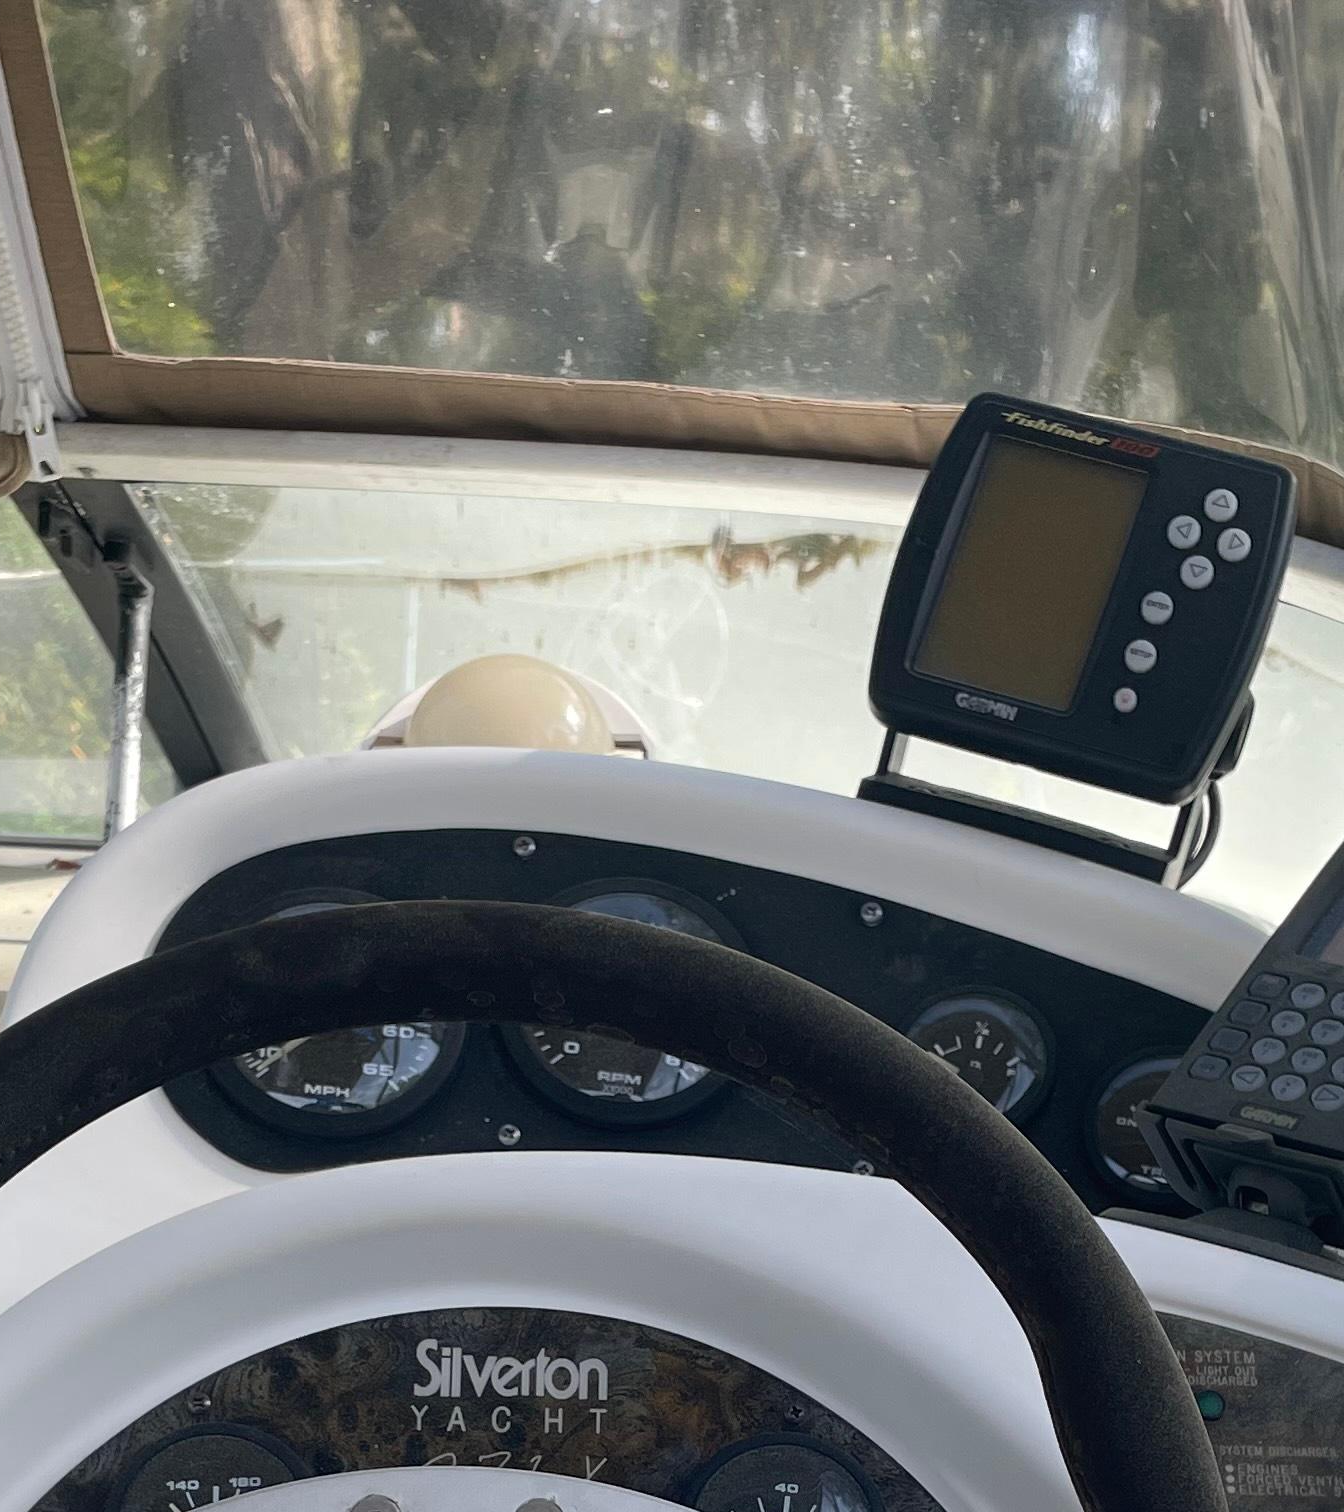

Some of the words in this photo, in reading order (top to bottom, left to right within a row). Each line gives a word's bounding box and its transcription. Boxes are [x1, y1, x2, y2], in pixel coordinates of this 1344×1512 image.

[956, 692, 1019, 721] GARMIN
[362, 1063, 394, 1077] 65
[596, 1070, 643, 1086] RPM
[303, 1084, 352, 1099] MPH
[1194, 1349, 1256, 1364] SYSTEM
[413, 1338, 608, 1400] Silverton
[410, 1404, 608, 1435] YACHT
[166, 1480, 200, 1491] 140
[774, 1483, 799, 1494] 40
